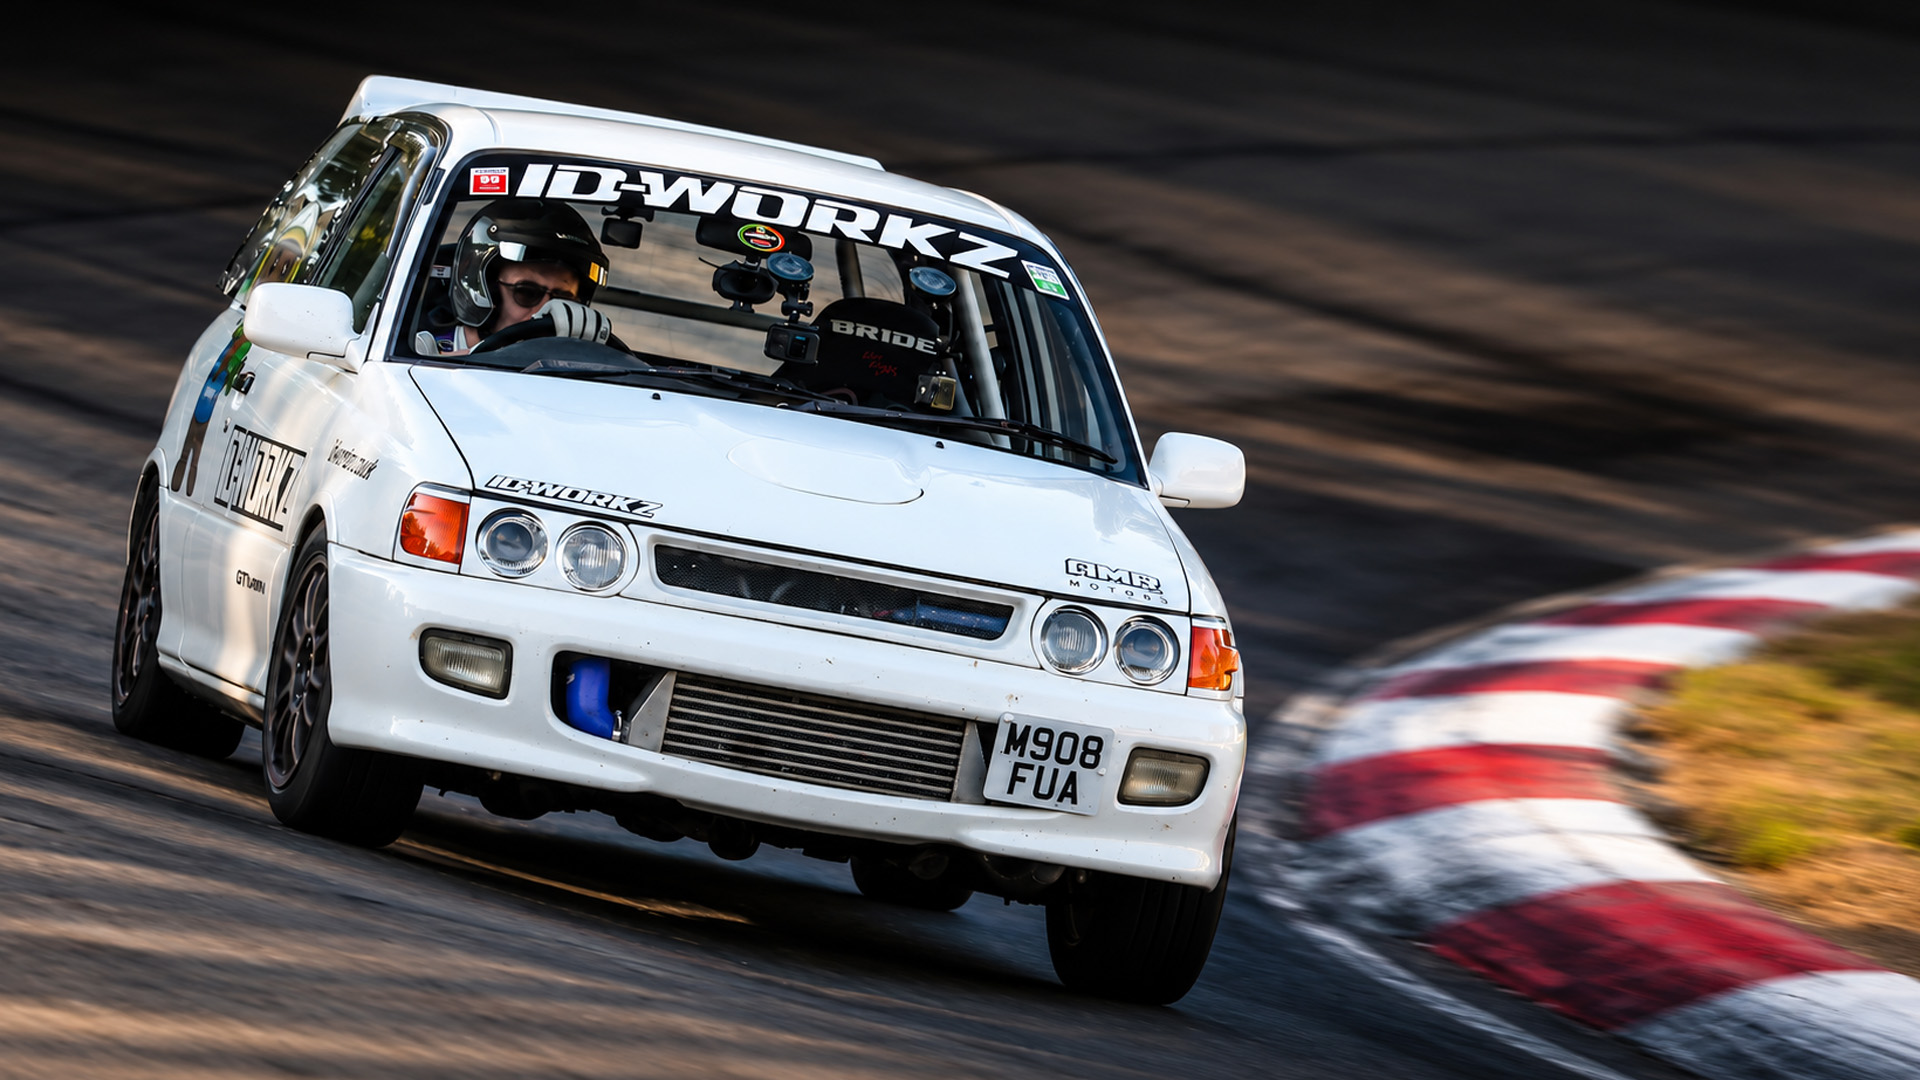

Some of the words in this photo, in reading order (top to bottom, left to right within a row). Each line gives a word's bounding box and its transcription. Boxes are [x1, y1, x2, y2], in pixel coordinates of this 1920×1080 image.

[514, 162, 1019, 279] ID-WORKZ
[829, 318, 938, 356] BRIDE
[484, 474, 663, 519] ID-WORKZ
[1064, 557, 1164, 595] AMR
[1003, 722, 1104, 770] M908
[1006, 761, 1079, 805] FUA
